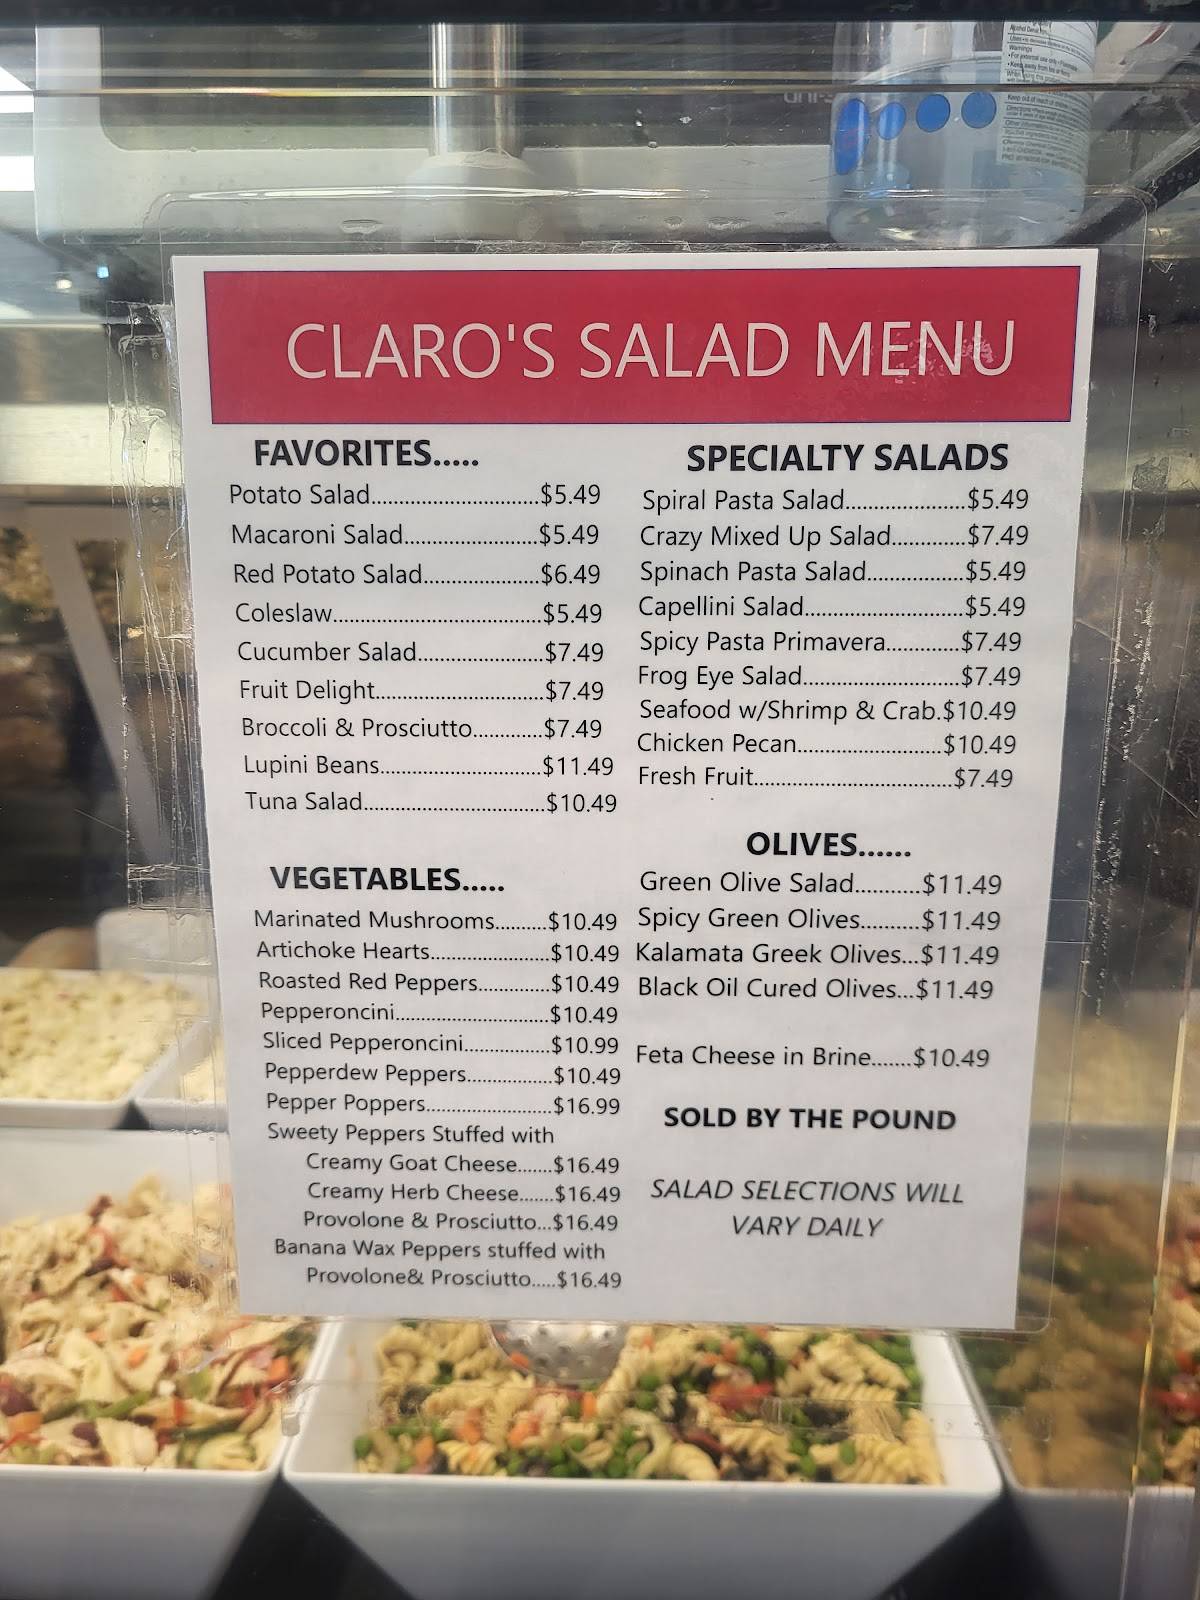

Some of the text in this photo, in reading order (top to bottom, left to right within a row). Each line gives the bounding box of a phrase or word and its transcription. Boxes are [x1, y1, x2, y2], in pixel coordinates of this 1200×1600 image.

[1009, 45, 1032, 53] Warnings
[1008, 94, 1020, 102] Keep
[287, 319, 1015, 380] CLARO'S SALAD MENU
[687, 442, 1009, 473] SPECIALTY SALADS
[229, 483, 302, 505] Potato
[540, 481, 601, 508] $5.49
[642, 488, 706, 516] Spiral
[715, 489, 774, 511] Pasta
[967, 486, 1029, 512] $5.49
[231, 523, 335, 545] Macaroni
[539, 522, 600, 548] $5.49
[640, 525, 704, 552] Crazy
[711, 524, 780, 547] Mixed
[788, 525, 822, 552] Up
[967, 522, 1029, 549] $7.49
[233, 562, 275, 584] Red
[282, 563, 356, 585] Potato
[540, 561, 601, 587] $6.49
[640, 559, 729, 588] Spinach
[738, 560, 797, 582] Pasta
[965, 558, 1027, 584] $5.49
[543, 601, 603, 626] $5.49
[638, 594, 735, 622] Capellini
[964, 594, 1026, 620] $5.49
[237, 640, 352, 662] Cucumber
[545, 640, 604, 665] $7.49
[639, 629, 700, 657] Spicy
[707, 630, 765, 652] Pasta
[960, 629, 1022, 655] $7.49
[638, 664, 688, 691] Frog
[696, 665, 735, 691] Eye
[960, 664, 1022, 689] $7.49
[240, 678, 289, 700] Fruit
[545, 678, 604, 704] $7.49
[639, 697, 731, 720] Seafood
[738, 698, 848, 726] w/Shrimp
[855, 699, 876, 721] &
[942, 698, 1017, 723] $10.49
[241, 716, 327, 737] Broccoli
[335, 717, 356, 738] &
[544, 716, 602, 741] $7.49
[637, 731, 724, 753] Chicken
[943, 732, 1017, 757] $10.49
[243, 754, 308, 780] Lupini
[542, 754, 614, 779] $11.49
[638, 765, 696, 786] Fresh
[953, 766, 1014, 790] $7.49
[244, 791, 298, 811] Tuna
[546, 791, 618, 815] $10.49
[639, 870, 711, 892] Green
[719, 870, 782, 893] Olive
[922, 871, 1003, 897] $11.49
[254, 909, 361, 929] Marinated
[548, 910, 618, 933] $10.49
[637, 906, 701, 934] Spicy
[707, 907, 779, 929] Green
[921, 908, 1001, 933] $11.49
[256, 940, 356, 960] Artichoke
[550, 942, 620, 964] $10.49
[636, 941, 744, 963] Kalamata
[752, 942, 823, 964] Greek
[920, 943, 1000, 967] $11.49
[258, 970, 341, 990] Roasted
[348, 971, 387, 991] Red
[551, 972, 620, 995] $10.49
[638, 975, 699, 997] Black
[706, 976, 738, 997] Oil
[746, 977, 817, 999] Cured
[915, 977, 994, 1001] $11.49
[549, 1003, 619, 1026] $10.49
[262, 1030, 322, 1050] Sliced
[551, 1034, 619, 1056] $10.99
[636, 1044, 684, 1065] Feta
[691, 1044, 776, 1066] Cheese
[783, 1045, 804, 1066] in
[912, 1046, 990, 1069] $10.49
[265, 1061, 379, 1085] Pepperdew
[553, 1065, 622, 1086] $10.49
[266, 1091, 338, 1115] Pepper
[553, 1095, 621, 1117] $16.99
[663, 1106, 957, 1131] SOLD BY THE POUND
[267, 1121, 555, 1147] Sweety Peppers Stuffed with
[305, 1152, 384, 1176] Creamy
[389, 1153, 438, 1172] Goat
[553, 1154, 620, 1176] $16.49
[307, 1181, 385, 1205] Creamy
[391, 1183, 440, 1201] Herb
[554, 1183, 621, 1204] $16.49
[650, 1178, 964, 1204] SALAD SELECTIONS WILL
[303, 1210, 405, 1229] Provolone
[411, 1211, 430, 1229] &
[552, 1212, 619, 1232] $16.49
[732, 1214, 884, 1238] VARY DAILY
[274, 1237, 606, 1262] Banana Wax Peppers stuffed with
[306, 1266, 425, 1286] Provolone&
[556, 1269, 622, 1290] $16.49
